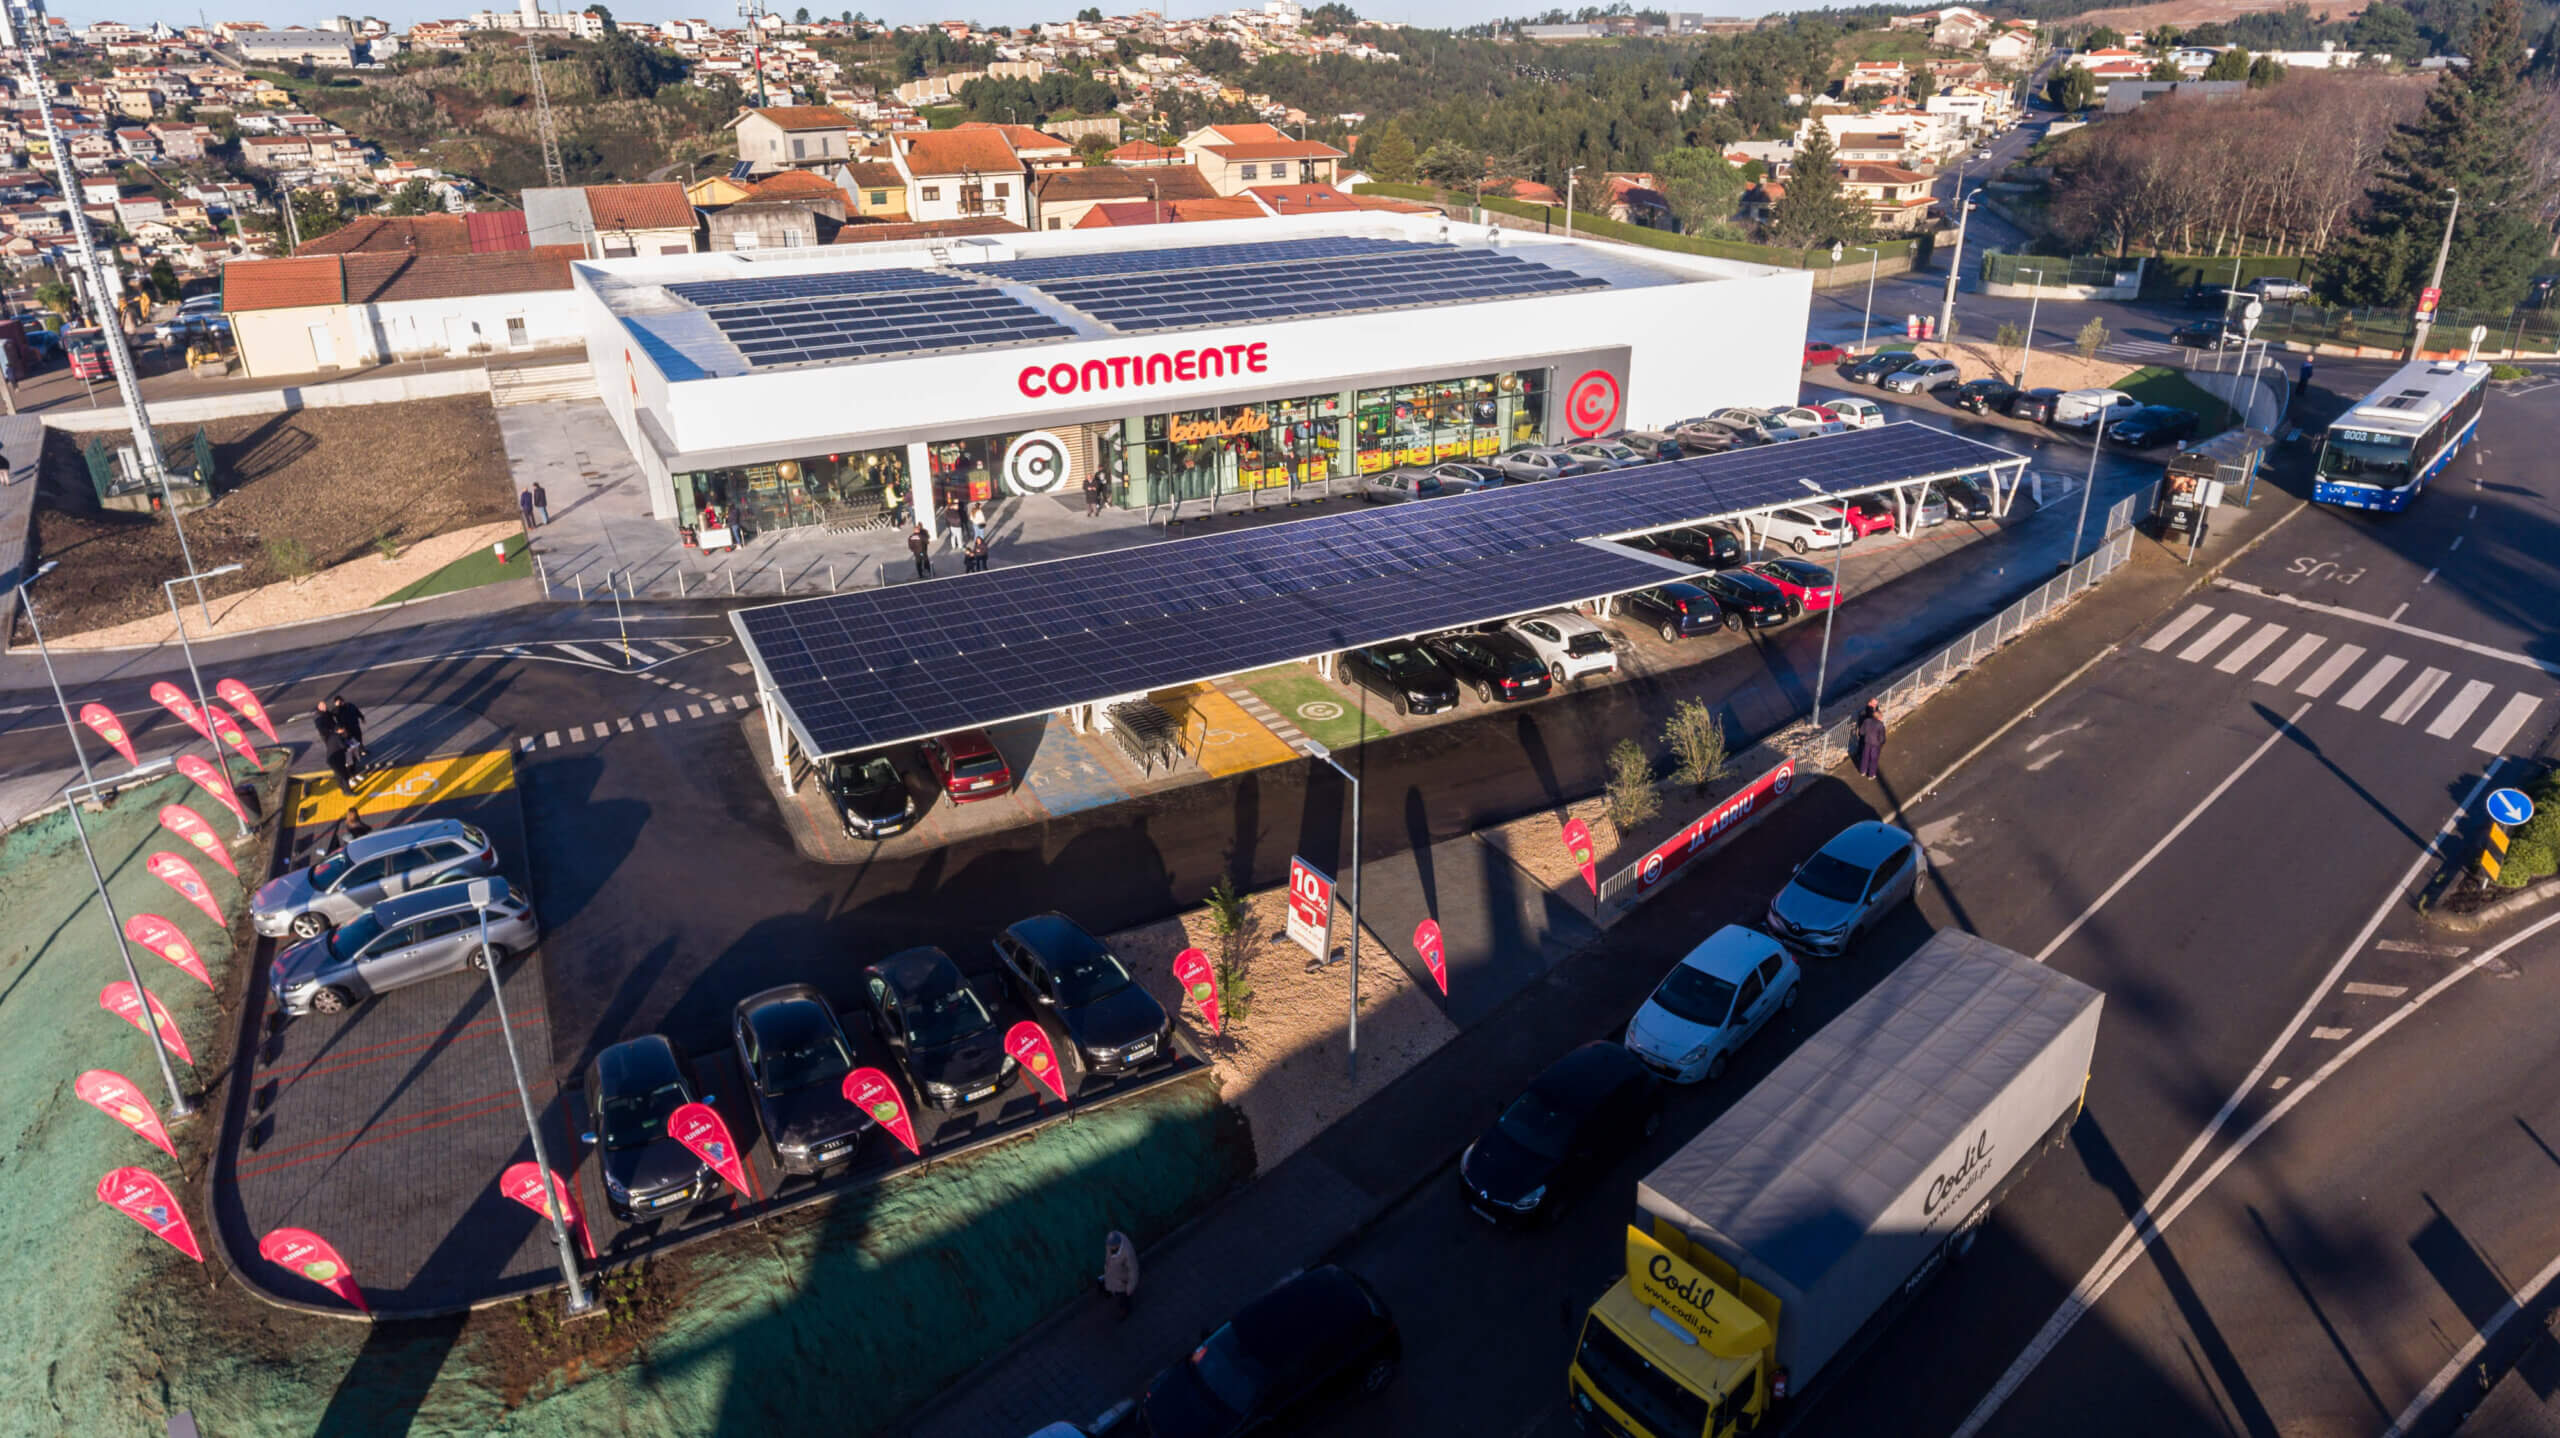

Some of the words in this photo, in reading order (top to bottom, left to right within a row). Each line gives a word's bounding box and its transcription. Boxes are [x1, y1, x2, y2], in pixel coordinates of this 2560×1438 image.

[1018, 342, 1268, 398] CONTINENTE
[1688, 822, 1706, 853] JÁ
[1709, 792, 1754, 838] ABRIU
[1923, 1129, 1995, 1216] Codil
[1643, 1281, 1713, 1338] www.codil.pt
[1649, 1255, 1720, 1324] Codil
